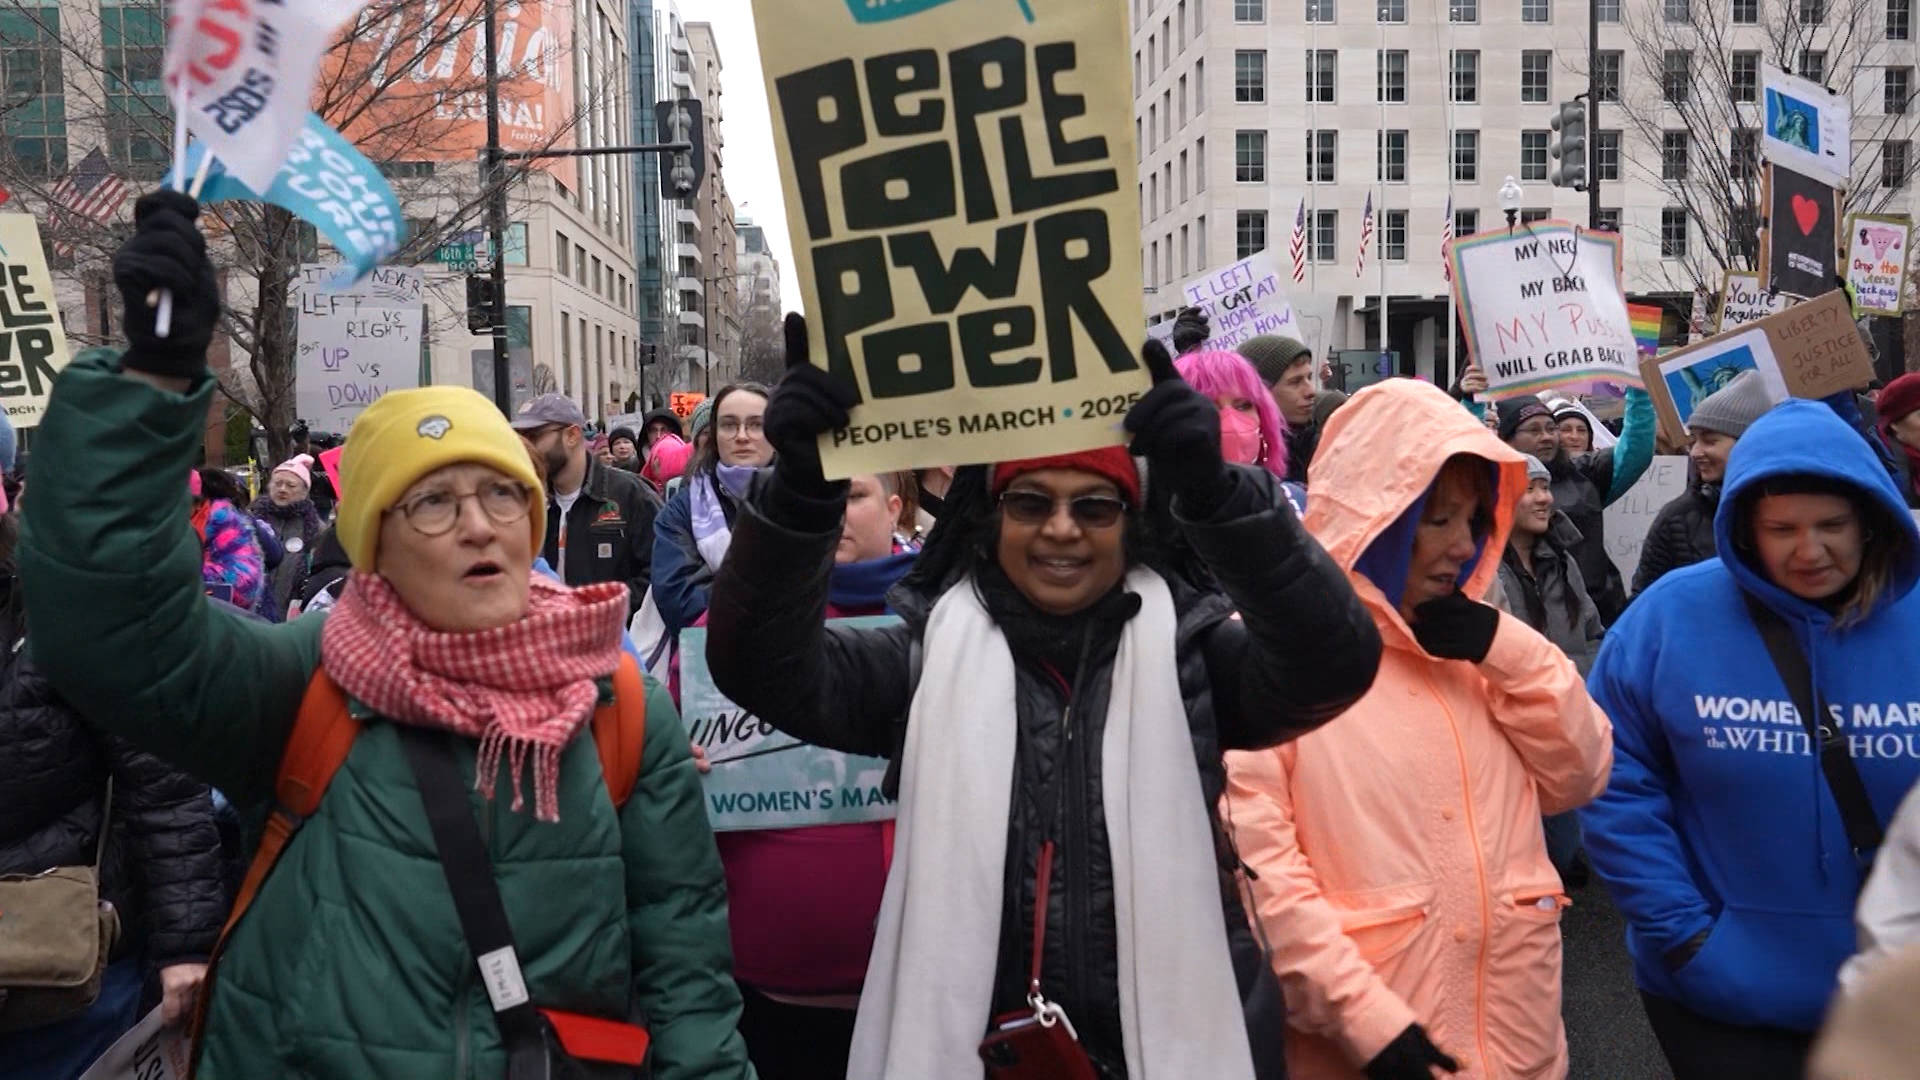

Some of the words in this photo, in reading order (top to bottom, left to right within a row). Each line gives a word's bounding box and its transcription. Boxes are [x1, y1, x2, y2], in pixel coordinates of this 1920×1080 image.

[1515, 242, 1540, 262] MY
[1548, 238, 1577, 255] NEC
[371, 269, 421, 296] NEVER
[1210, 260, 1255, 297] LEFT
[1520, 280, 1545, 300] MY
[303, 292, 366, 317] LEFT
[1222, 285, 1253, 311] CAT
[1257, 275, 1278, 299] AT
[1219, 302, 1263, 333] HOME
[1254, 310, 1290, 336] HOW
[1778, 305, 1839, 341] LIBERTY
[1495, 311, 1551, 355] MY
[322, 346, 350, 370] UP
[1496, 355, 1537, 378] WILL
[1545, 346, 1594, 370] GRAB
[1793, 331, 1857, 369] JUSTICE
[1801, 365, 1826, 386] FOR
[832, 417, 952, 448] PEOPLE'S
[959, 405, 1056, 435] MARCH
[1704, 726, 1717, 736] to
[710, 789, 834, 814] WOMEN'S
